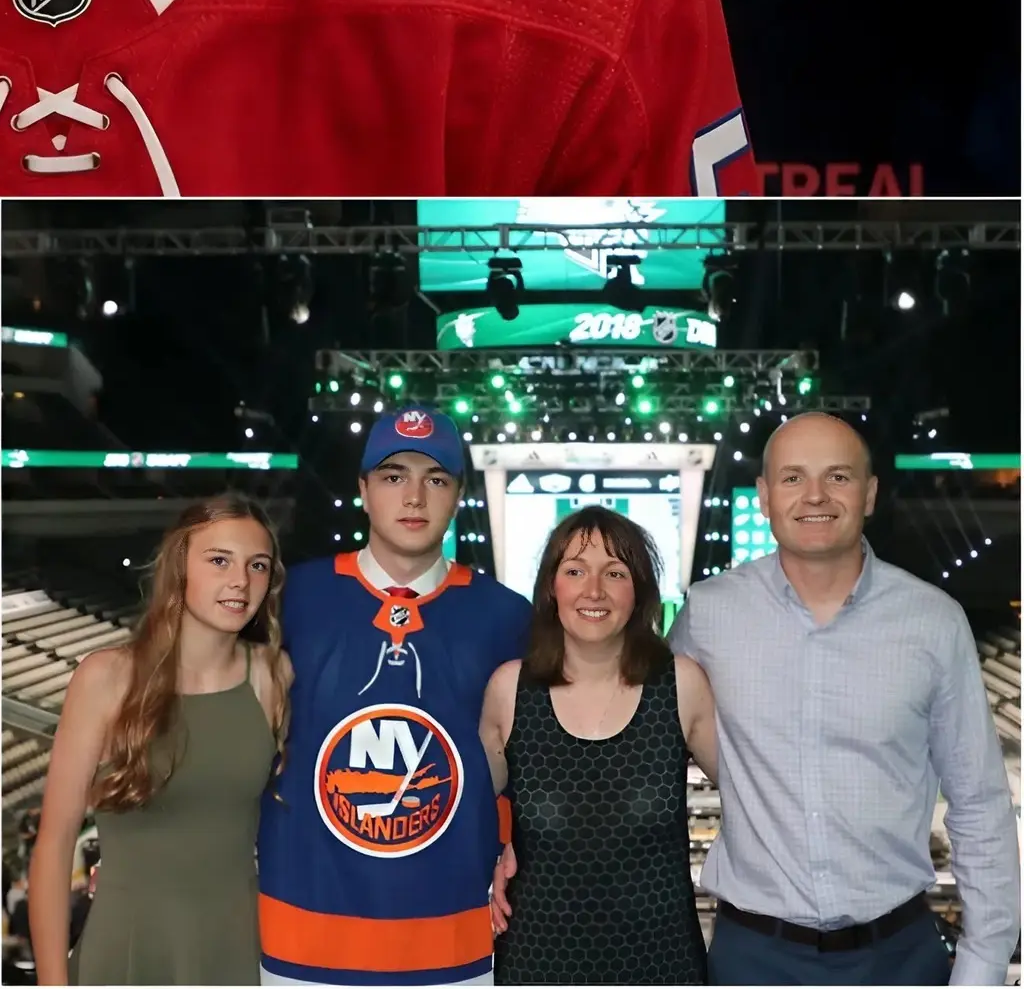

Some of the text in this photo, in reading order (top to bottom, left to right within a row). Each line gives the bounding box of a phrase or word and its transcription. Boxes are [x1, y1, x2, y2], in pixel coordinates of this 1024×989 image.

[569, 313, 642, 342] 2018
[349, 719, 434, 771] NY
[333, 792, 441, 841] ISLANDERS
